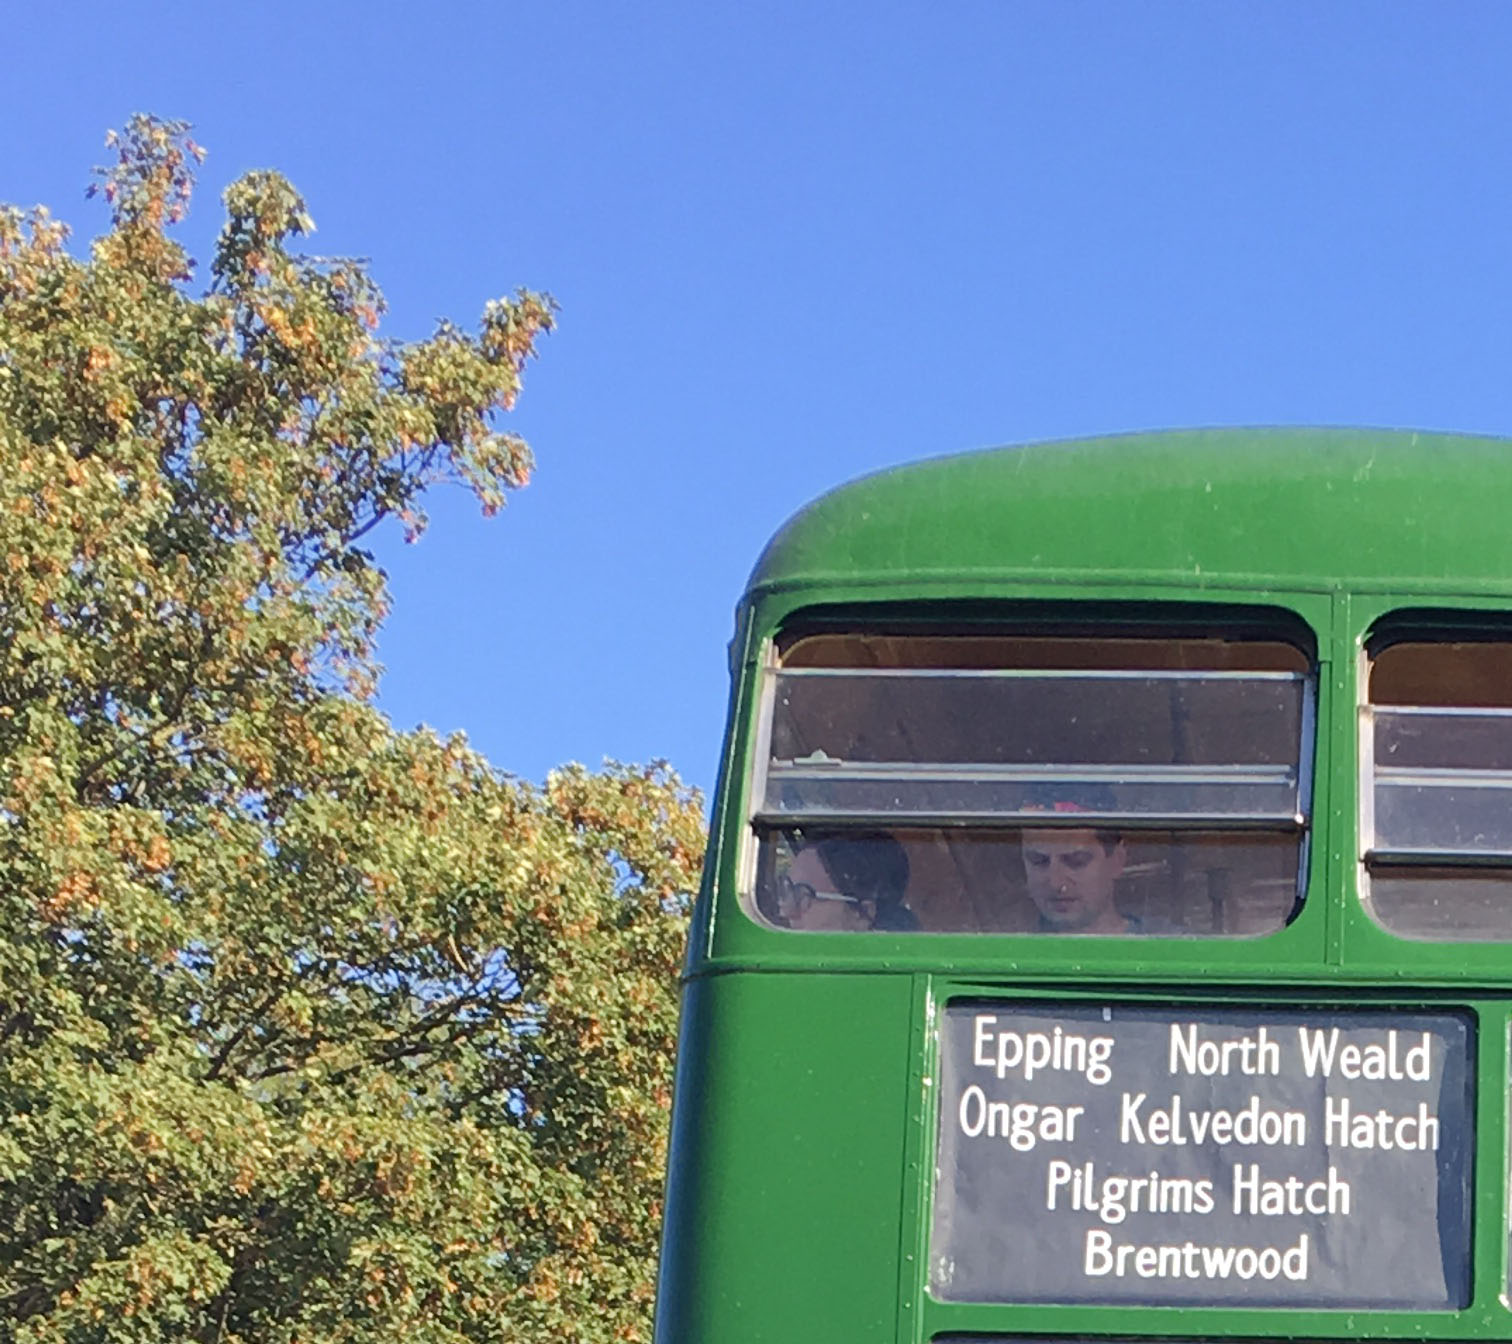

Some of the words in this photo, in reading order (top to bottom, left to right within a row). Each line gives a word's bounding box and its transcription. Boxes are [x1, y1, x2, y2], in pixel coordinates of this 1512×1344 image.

[974, 1015, 1114, 1085] Epping
[1170, 1023, 1280, 1077] North
[1300, 1027, 1431, 1081] Weald
[959, 1085, 1084, 1151] Ongar
[1121, 1093, 1305, 1146] Kelvedon
[1325, 1096, 1439, 1151] Hatch
[1047, 1160, 1215, 1224] Pilgrims
[1233, 1163, 1351, 1215] Hatch
[1085, 1229, 1309, 1281] Brentwood
